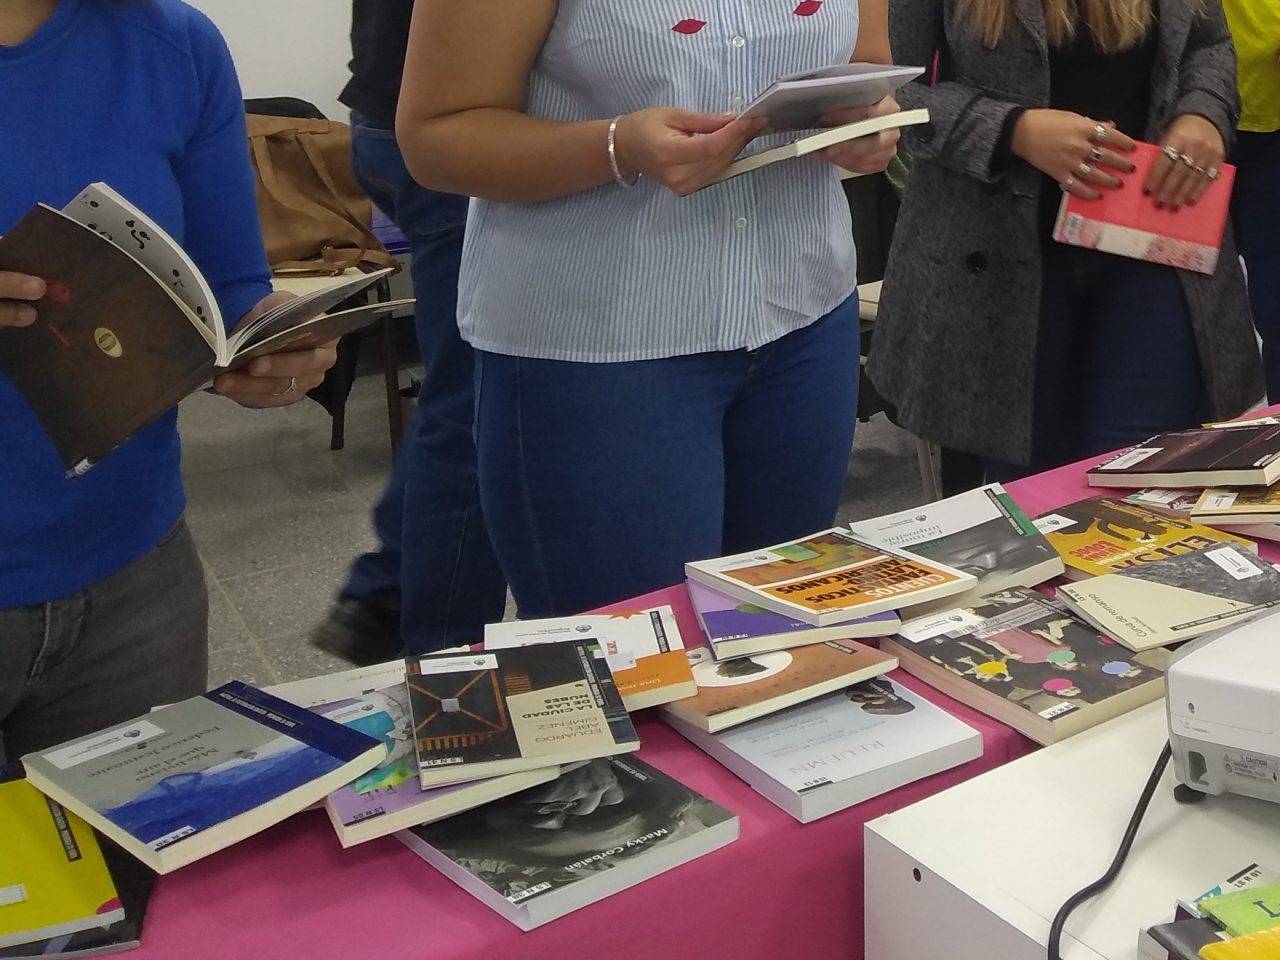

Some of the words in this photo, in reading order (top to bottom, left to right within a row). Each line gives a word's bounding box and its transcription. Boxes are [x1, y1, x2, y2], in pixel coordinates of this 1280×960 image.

[864, 574, 945, 598] CUENTOS
[543, 693, 589, 704] NUBES
[545, 701, 573, 709] LAS
[521, 705, 581, 719] CIUDAD
[535, 729, 603, 743] EDUARDO
[626, 828, 668, 848] Macky
[564, 847, 624, 873] Corbalán
